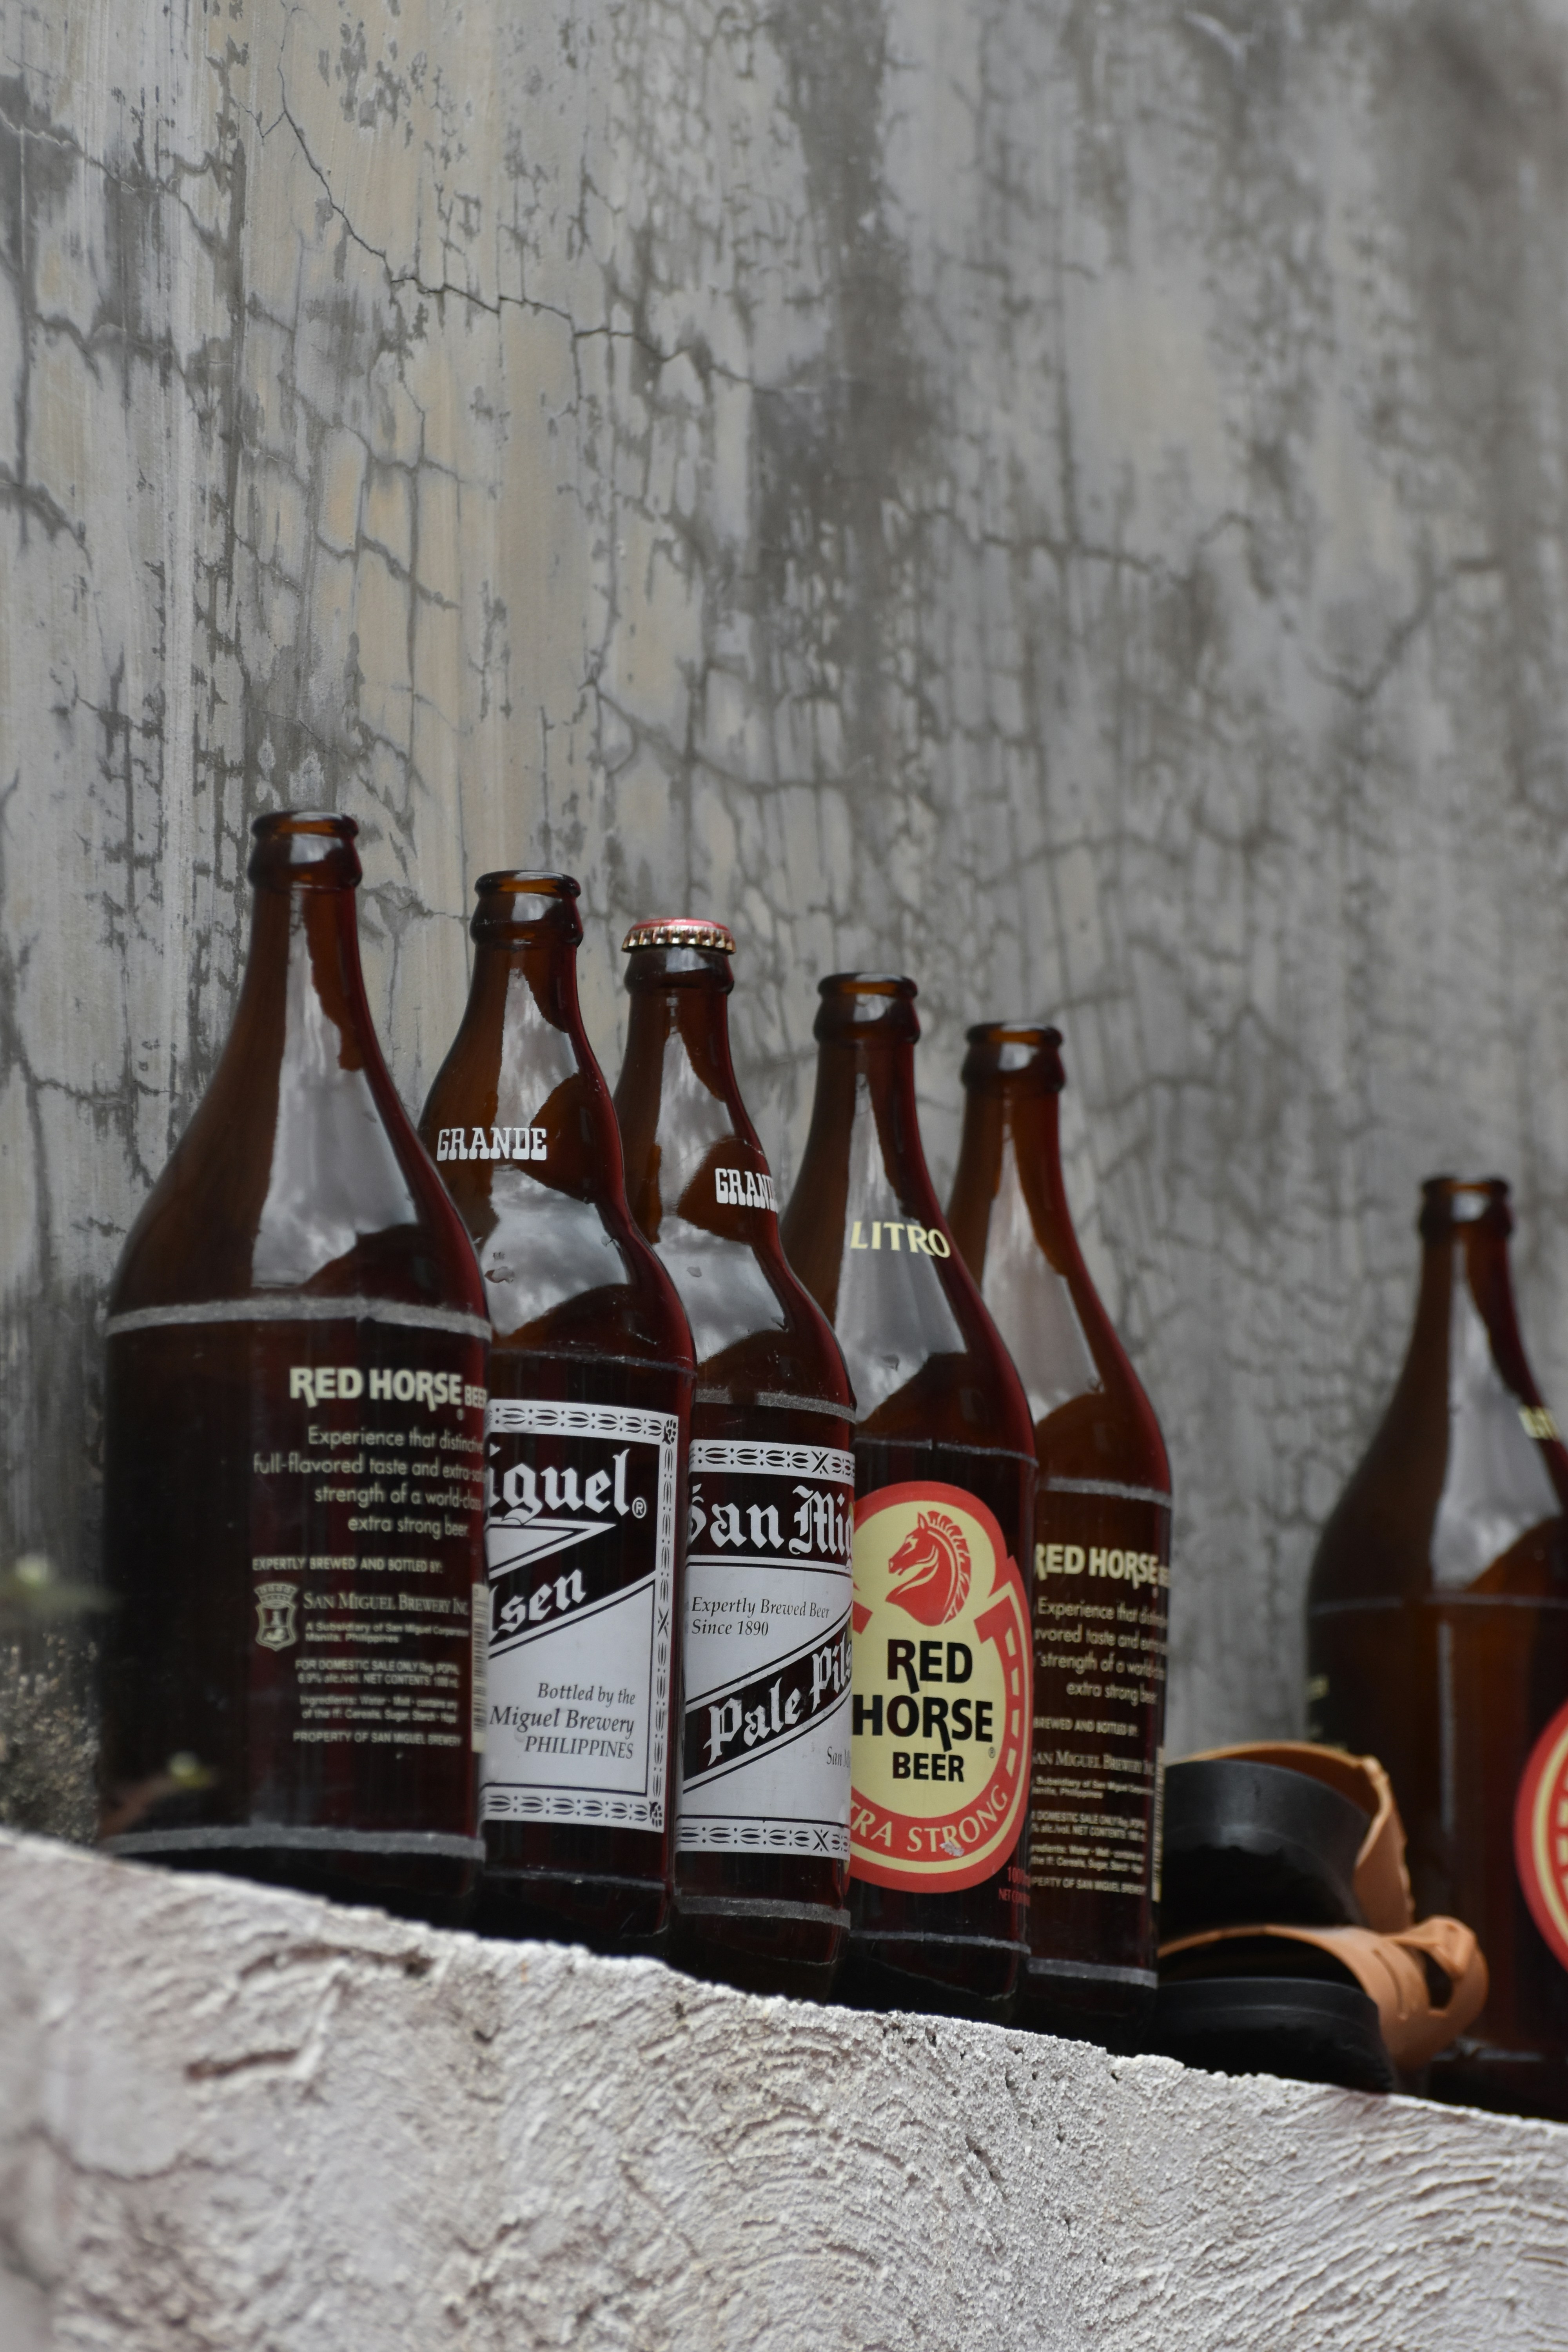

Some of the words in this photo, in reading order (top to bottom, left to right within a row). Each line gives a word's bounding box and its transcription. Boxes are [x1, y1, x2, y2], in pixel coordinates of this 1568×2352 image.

[437, 1127, 546, 1161] GRANDE
[715, 1168, 779, 1214] GRAND
[850, 1221, 951, 1258] LITRO
[290, 1367, 364, 1408] RED
[369, 1368, 463, 1412] HORSE
[308, 1425, 405, 1450] Experience
[409, 1426, 437, 1447] that
[254, 1452, 365, 1474] full-flavored
[370, 1457, 408, 1475] taste
[412, 1456, 440, 1477] and
[315, 1481, 385, 1508] strength
[390, 1482, 408, 1503] of
[411, 1491, 422, 1504] a
[348, 1516, 392, 1532] extra
[397, 1516, 442, 1540] strong
[252, 1557, 306, 1570] EXPERTLY
[310, 1557, 357, 1570] BREWED
[360, 1558, 386, 1571] AND
[388, 1559, 428, 1573] BOTTLED
[1035, 1543, 1085, 1581] RED
[1089, 1546, 1159, 1590] HORSE
[691, 1597, 756, 1618] Expertly
[761, 1598, 806, 1617] Brewed
[809, 1602, 830, 1619] Beer
[1038, 1595, 1114, 1620] Experience
[1117, 1601, 1138, 1622] that
[373, 1622, 383, 1632] of
[691, 1619, 732, 1636] Since
[737, 1621, 769, 1636] 1890
[1086, 1628, 1116, 1646] taste
[1118, 1630, 1140, 1649] and
[295, 1659, 316, 1670] FOR
[318, 1658, 370, 1671] DOMESTIC
[372, 1659, 395, 1671] SALE
[396, 1660, 419, 1671] ONLY
[887, 1639, 973, 1694] RED
[1040, 1650, 1097, 1675] strength
[1100, 1651, 1115, 1672] of
[363, 1673, 383, 1684] NET
[537, 1683, 593, 1702] Bottled
[597, 1687, 614, 1708] by
[618, 1689, 635, 1705] the
[1066, 1680, 1102, 1697] extra
[1105, 1683, 1139, 1706] strong
[489, 1706, 561, 1733] Miguel
[565, 1710, 634, 1740] Brewery
[703, 1677, 803, 1766] Pale
[852, 1694, 993, 1752] HORSE
[293, 1730, 352, 1742] PROPERTY
[354, 1731, 369, 1743] OF
[371, 1732, 392, 1743] SAN
[524, 1736, 634, 1759] PHILIPPINES
[826, 1746, 842, 1767] San
[893, 1752, 964, 1783] BEER
[906, 1785, 1008, 1853] STRONG
